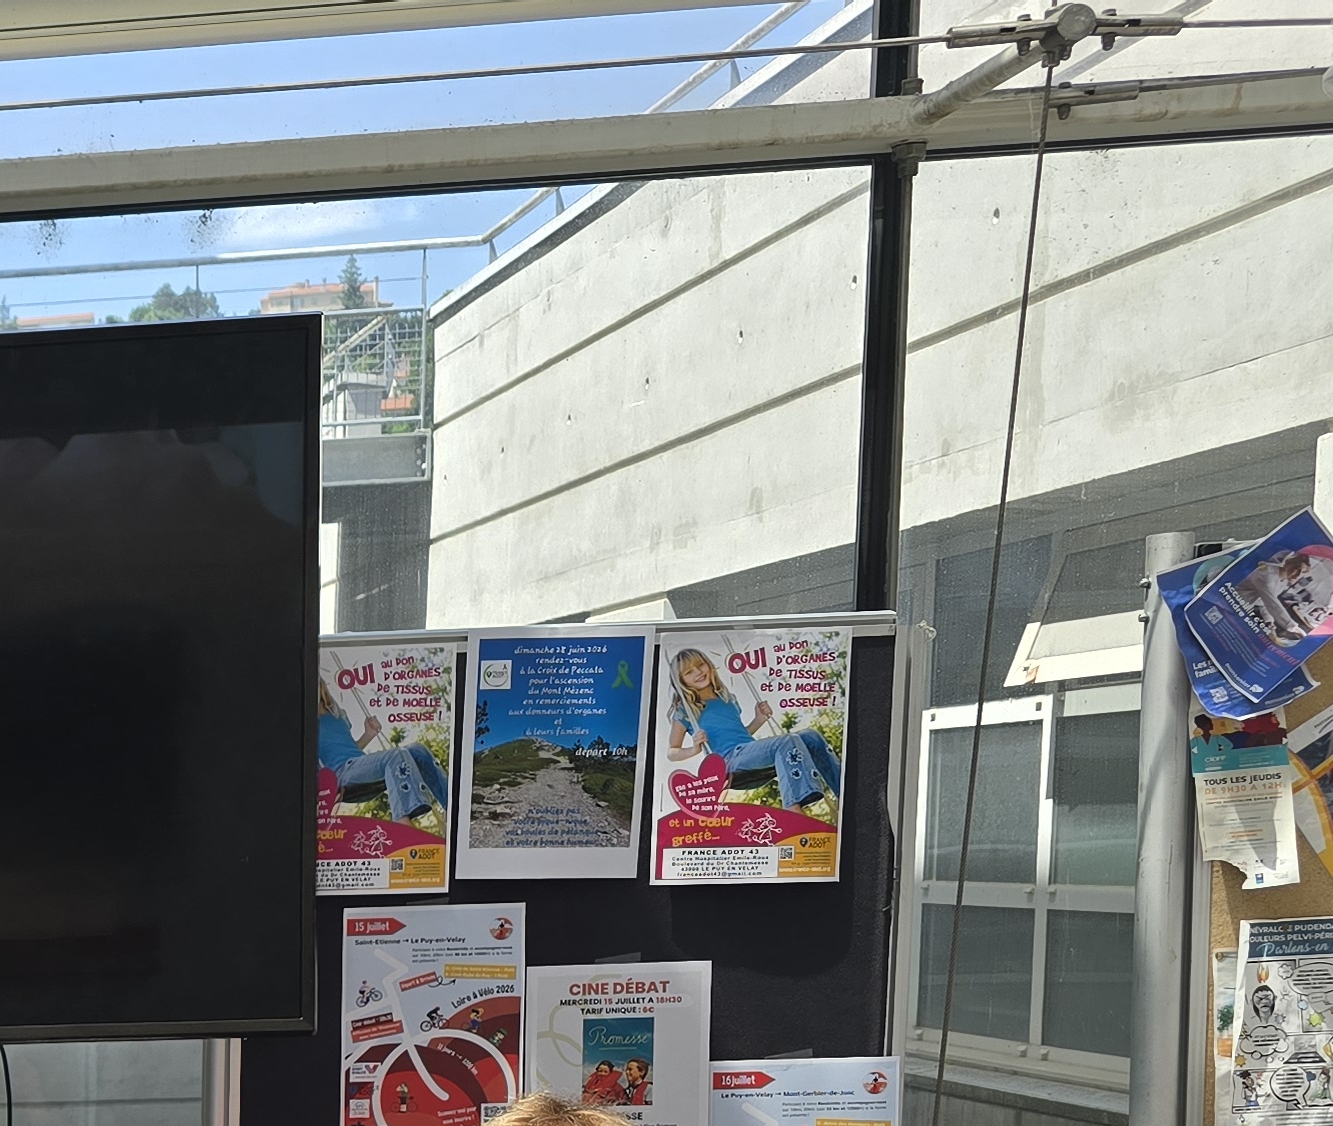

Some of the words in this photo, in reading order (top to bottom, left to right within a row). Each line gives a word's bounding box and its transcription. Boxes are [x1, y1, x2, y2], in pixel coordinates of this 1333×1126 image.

[514, 645, 555, 655] dimanche
[568, 646, 586, 655] juin
[587, 644, 608, 653] 2026
[535, 655, 588, 664] rendez-vous
[728, 647, 767, 674] OUI
[776, 652, 836, 665] D'ORGANES
[788, 669, 826, 680] TISSUS
[529, 677, 548, 686] pour
[550, 675, 594, 685] l'ascension
[795, 682, 836, 693] MOELLE
[779, 697, 828, 709] OSSEUSE
[1204, 778, 1228, 787] TOUS
[1230, 775, 1247, 784] LES
[1249, 772, 1282, 784] JEUDIS
[568, 982, 609, 997] CINE
[613, 977, 671, 995] DÉBAT
[559, 999, 603, 1007] MERCREDI
[615, 997, 646, 1005] JUILLET
[656, 996, 682, 1004] 18H30
[588, 1026, 650, 1046] Promesse
